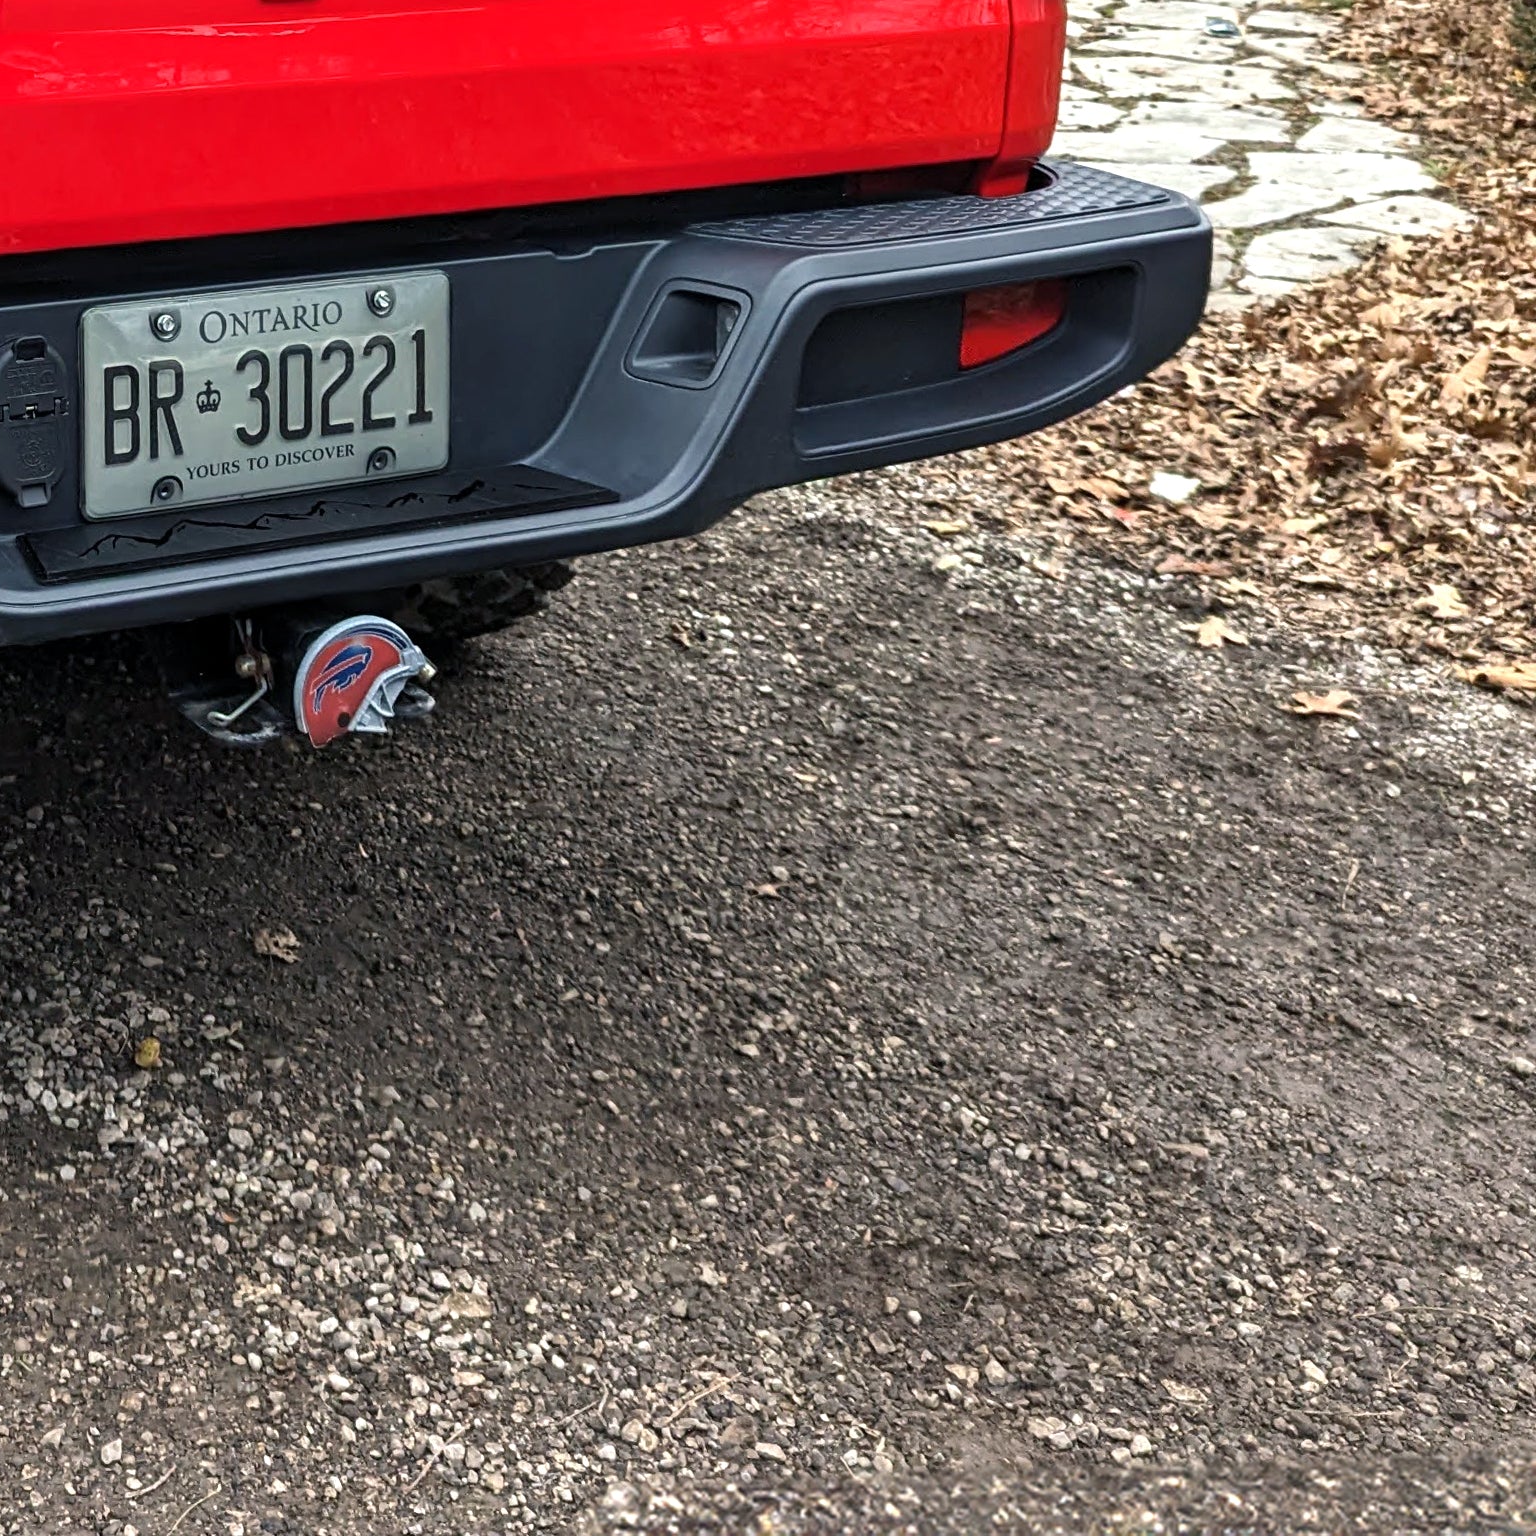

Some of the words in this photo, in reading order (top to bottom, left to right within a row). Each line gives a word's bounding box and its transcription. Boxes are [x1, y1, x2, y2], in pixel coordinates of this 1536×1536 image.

[199, 300, 343, 344] ONTARIO
[103, 359, 185, 466] BR
[235, 328, 434, 446] 30221
[186, 459, 241, 480] YOURS
[246, 455, 269, 472] TO
[275, 443, 356, 468] DISCOVER
